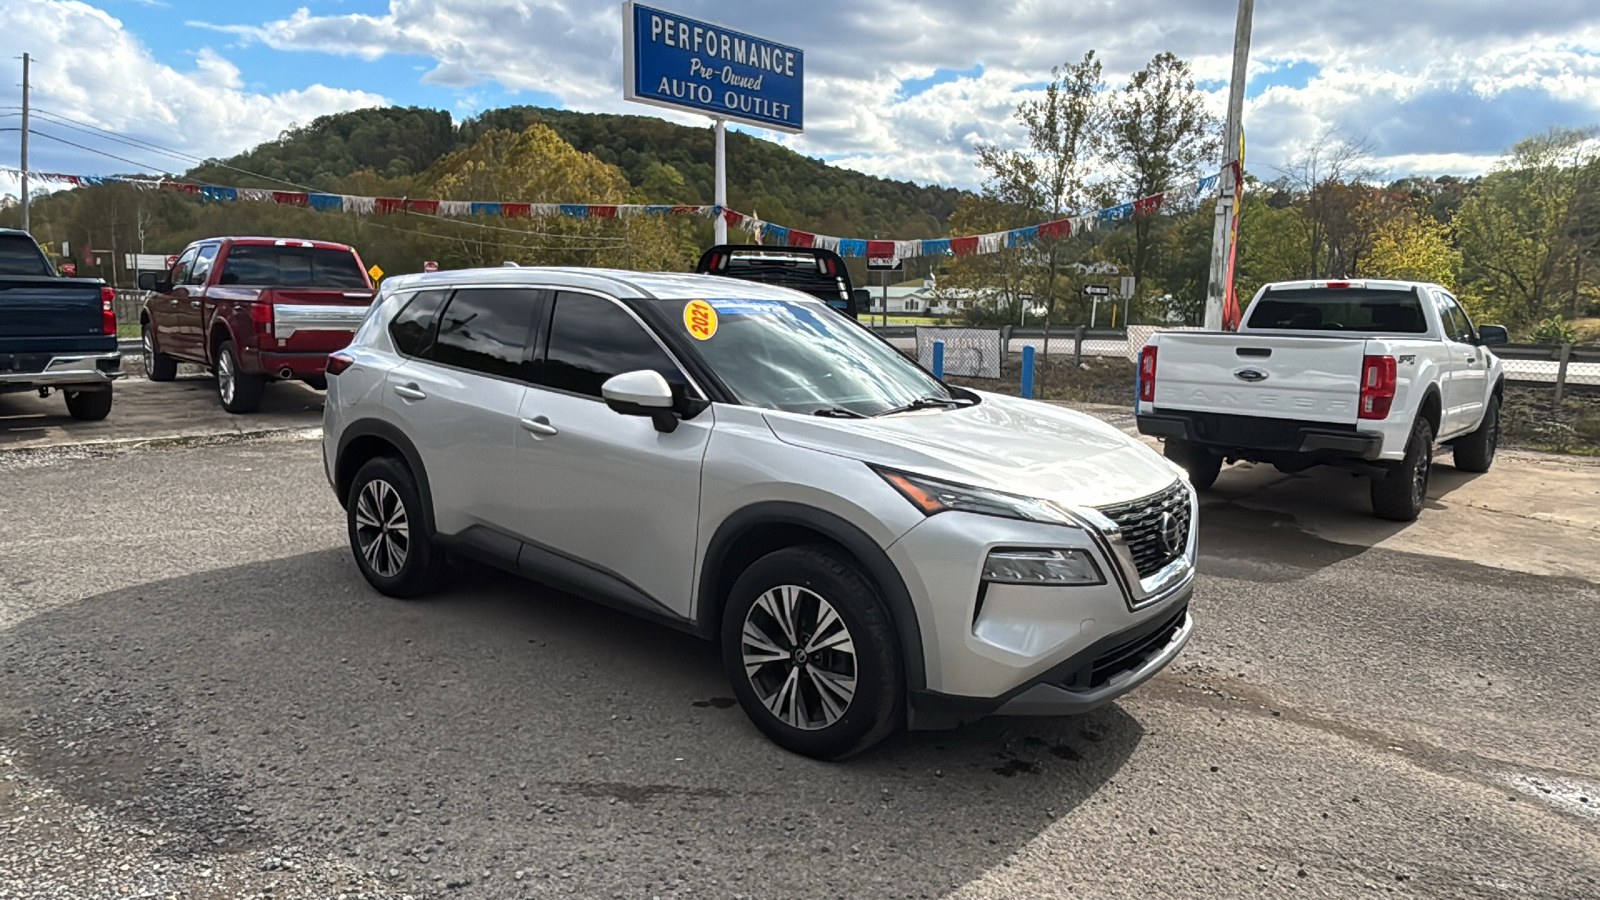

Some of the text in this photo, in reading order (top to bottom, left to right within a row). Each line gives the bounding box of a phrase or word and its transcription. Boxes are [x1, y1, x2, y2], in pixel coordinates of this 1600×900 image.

[651, 15, 795, 77] PERFORMANCE
[689, 57, 764, 91] Pre-Owned
[657, 76, 791, 121] AUTO OUTLET
[691, 302, 709, 336] 2021
